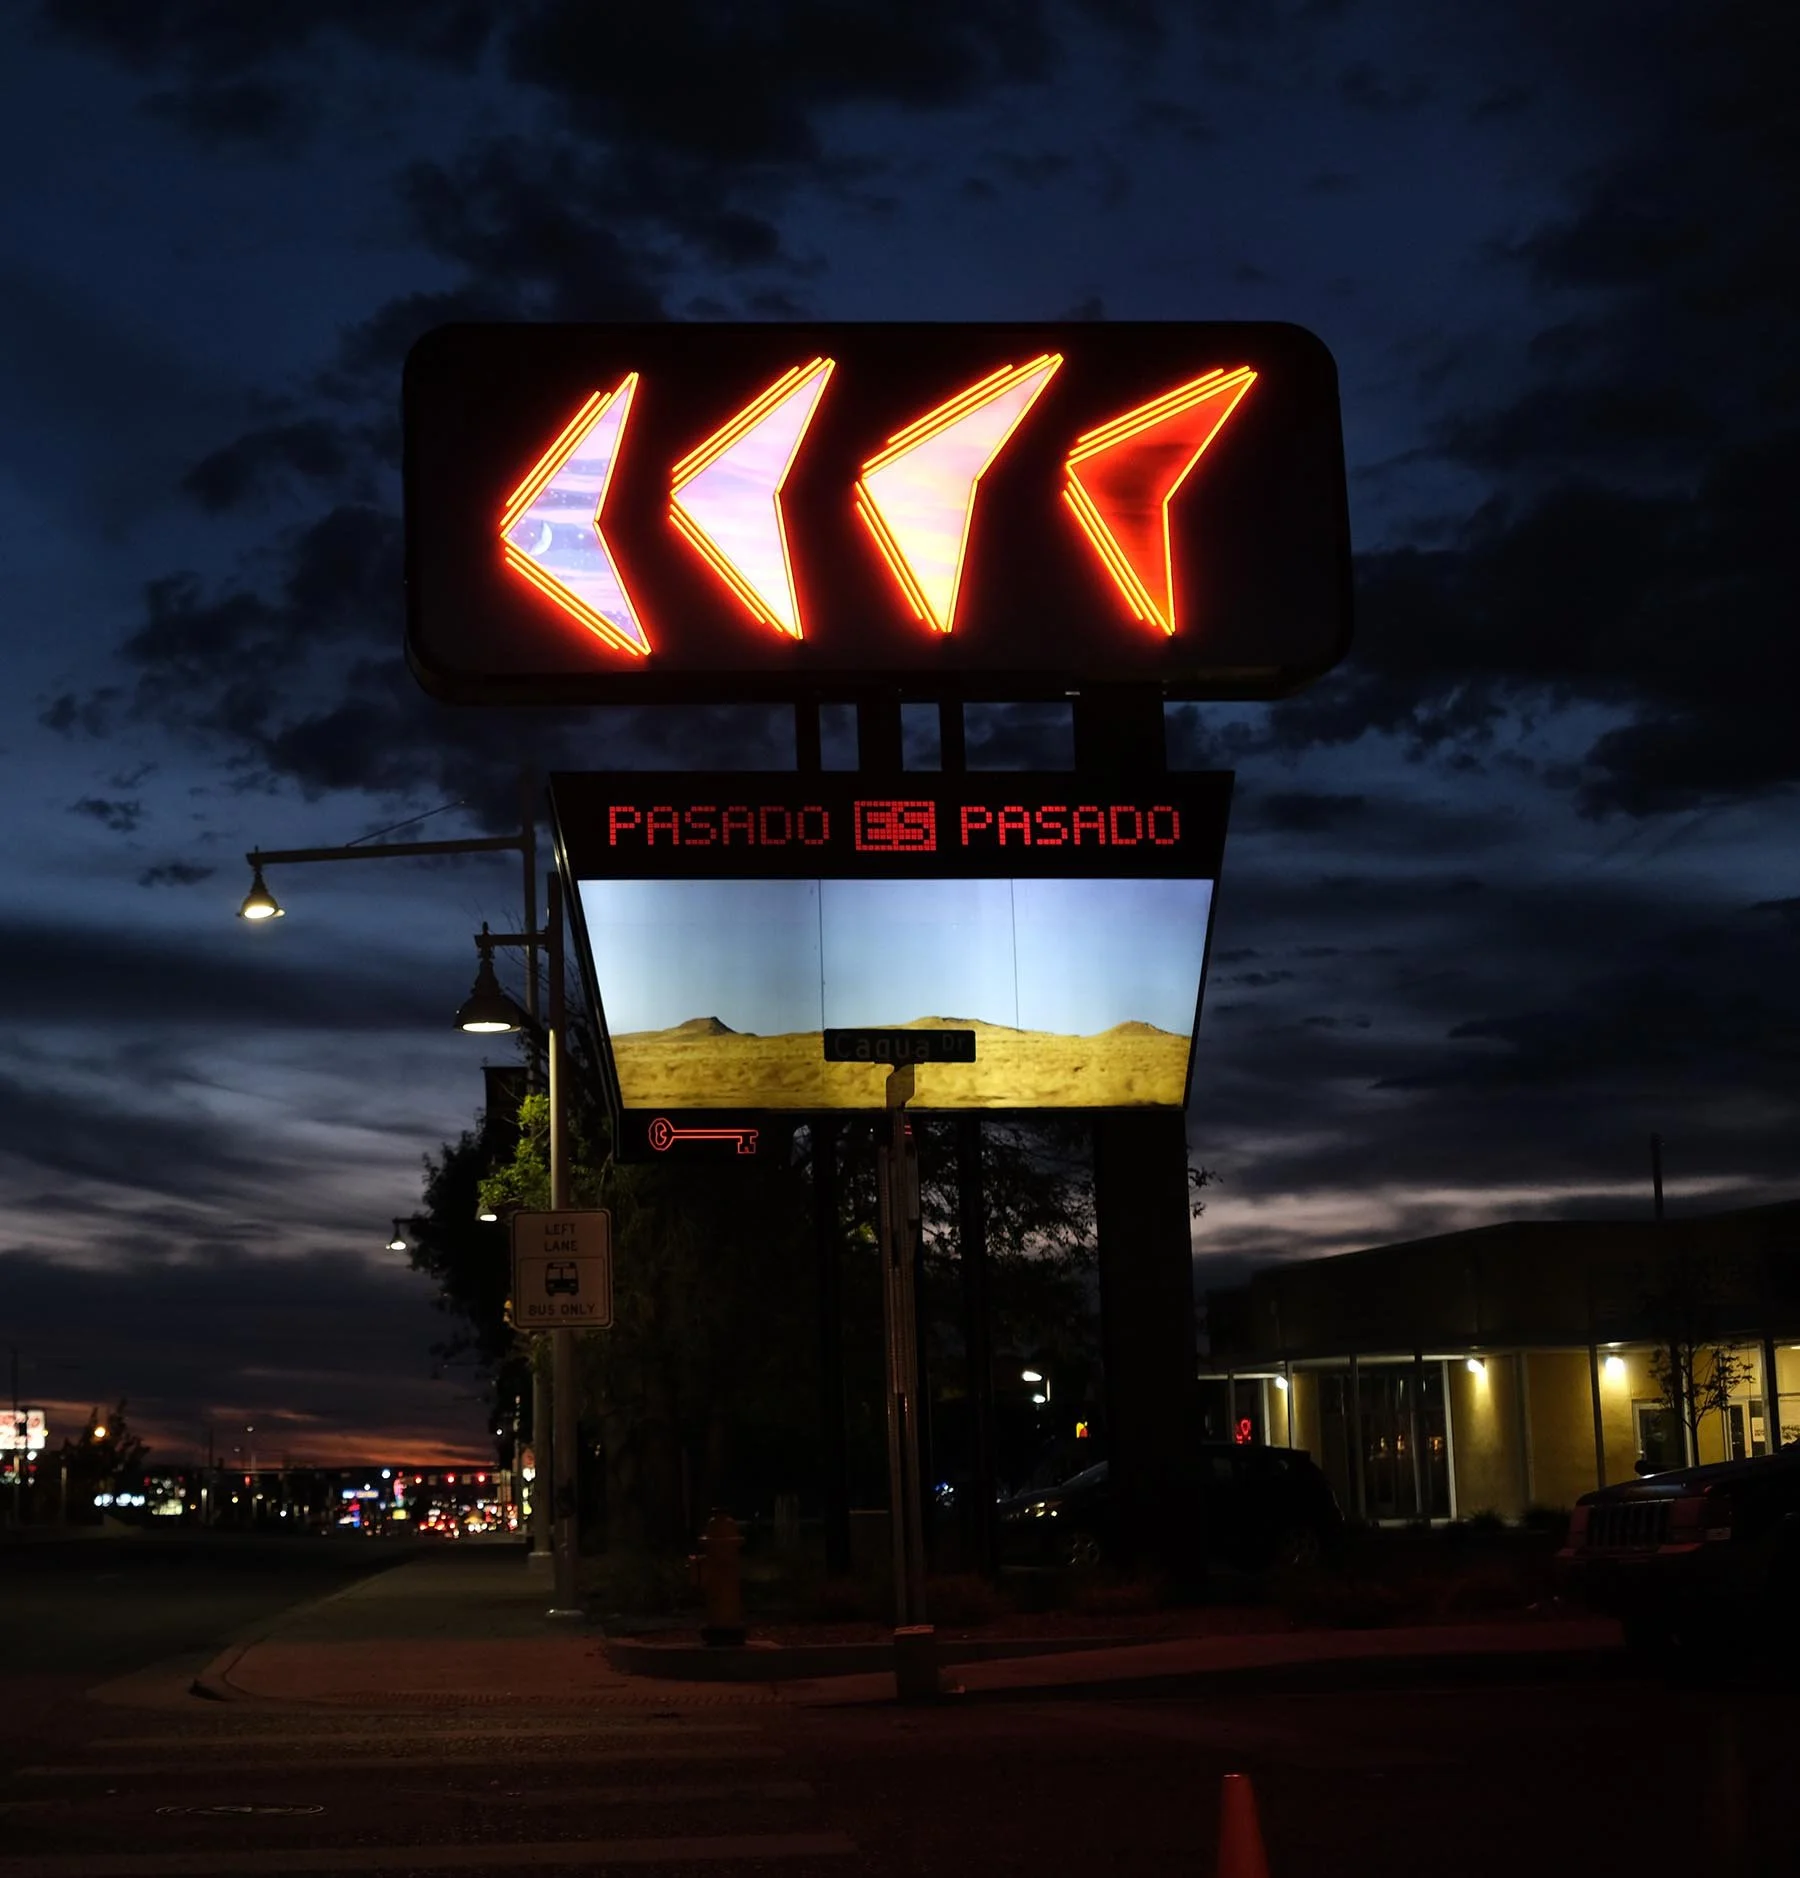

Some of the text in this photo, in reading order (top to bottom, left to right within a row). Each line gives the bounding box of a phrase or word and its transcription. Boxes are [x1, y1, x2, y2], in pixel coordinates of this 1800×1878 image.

[609, 805, 1180, 846] PASADO ES PASADO
[942, 1033, 967, 1053] Dr
[545, 1223, 576, 1235] LEFT
[544, 1240, 578, 1252] LANE
[528, 1303, 596, 1316] BUS ONLY
